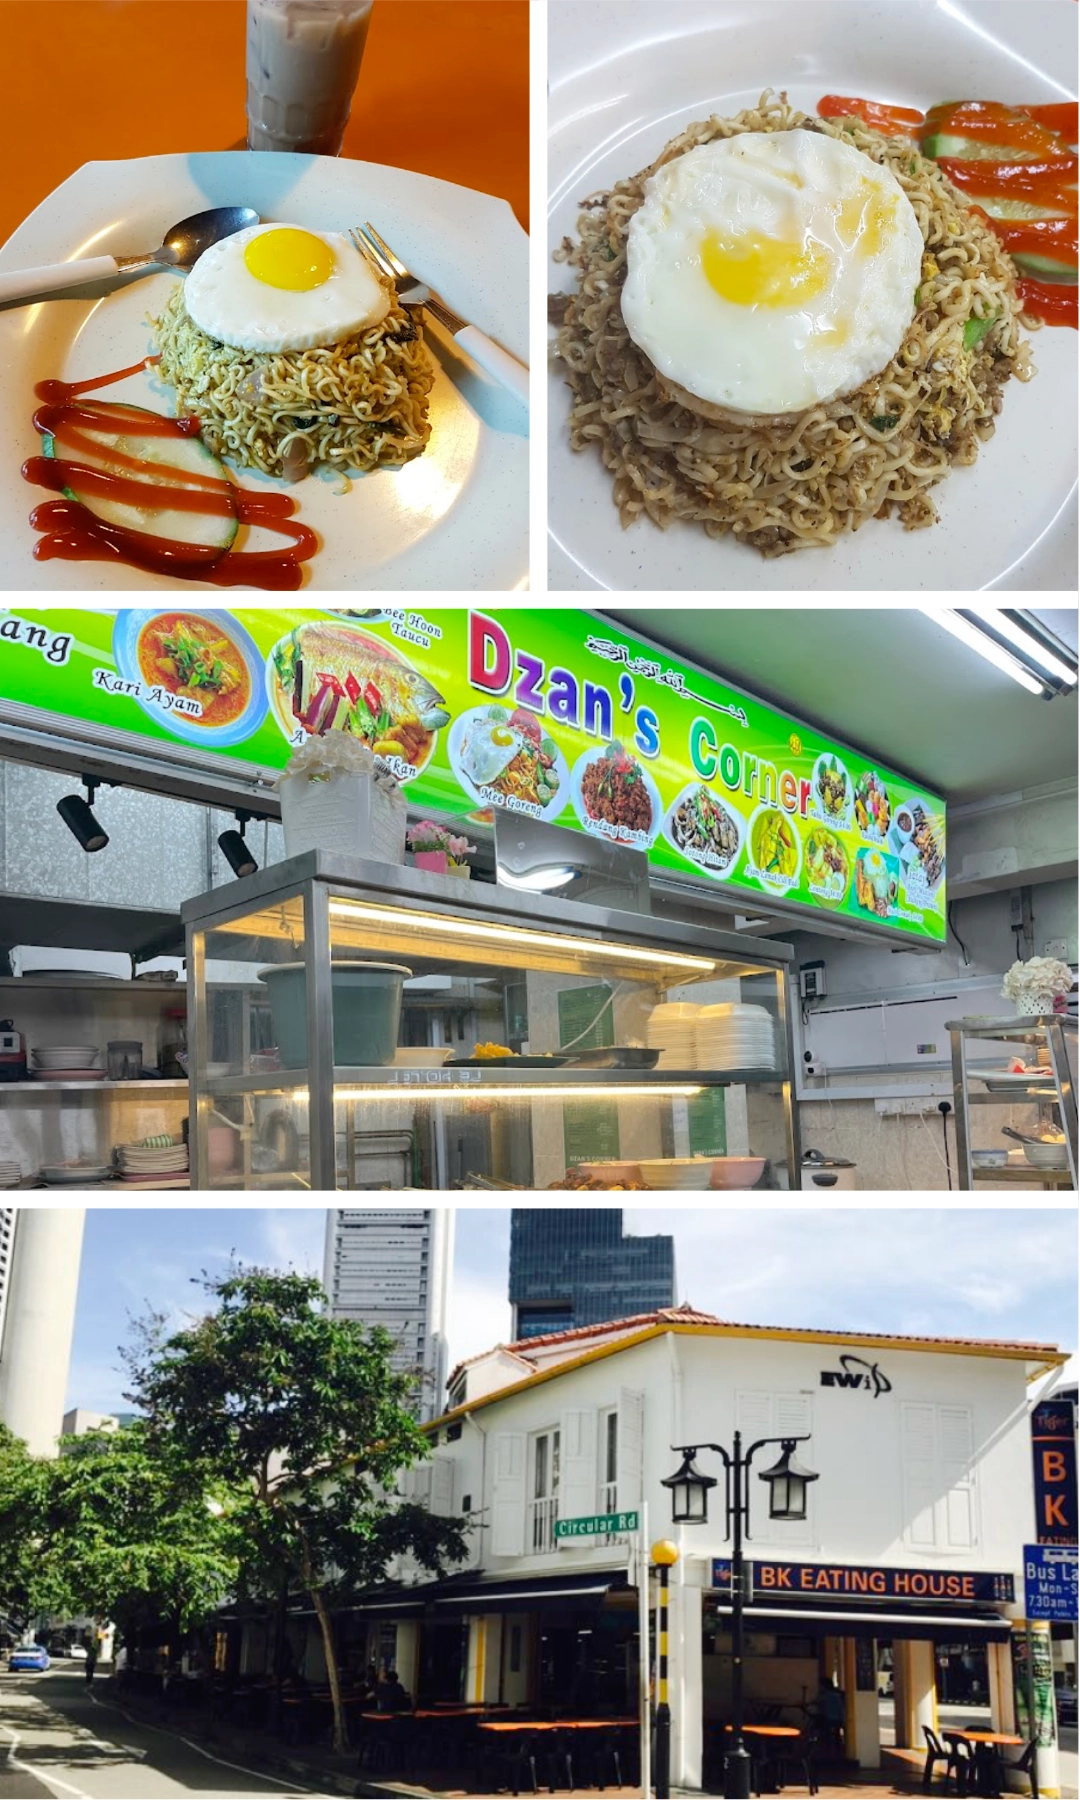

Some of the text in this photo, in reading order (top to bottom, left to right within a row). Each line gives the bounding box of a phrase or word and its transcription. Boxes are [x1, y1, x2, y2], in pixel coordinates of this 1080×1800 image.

[383, 609, 441, 637] Bee Hoon
[392, 623, 429, 646] Taucu
[96, 671, 200, 714] Kari Ayam
[469, 609, 812, 820] Dzan's Corner
[386, 757, 417, 777] Ikan
[481, 788, 543, 818] Mee Goreng
[559, 1513, 636, 1535] Circular Rd
[760, 1566, 976, 1598] BK EATING HOUSE
[1027, 1562, 1056, 1580] Bus
